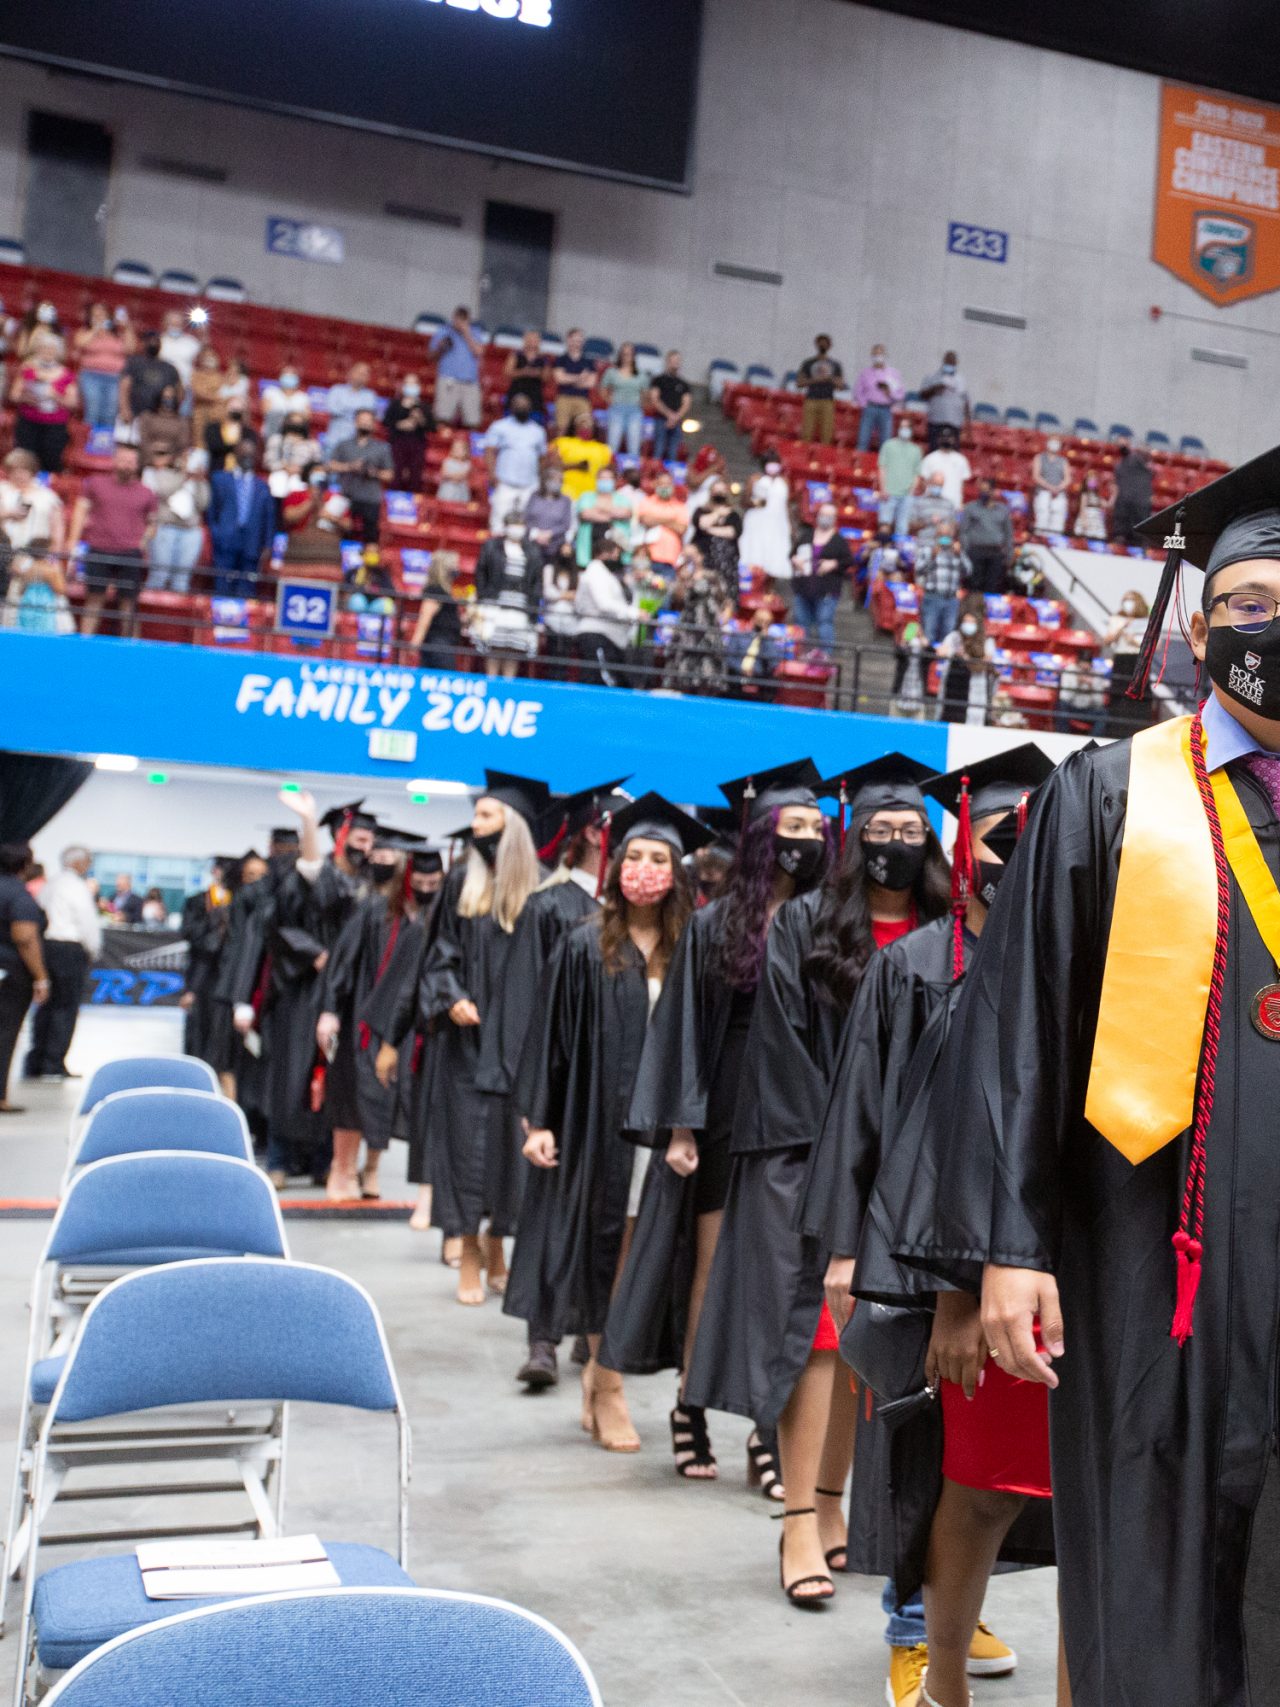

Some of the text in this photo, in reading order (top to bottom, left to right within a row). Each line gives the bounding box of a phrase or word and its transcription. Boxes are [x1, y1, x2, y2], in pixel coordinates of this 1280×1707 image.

[952, 227, 1002, 258] 233
[1163, 535, 1186, 549] 2021
[286, 594, 327, 624] 32
[300, 663, 487, 698] LAKELAND MAGIC
[1229, 672, 1264, 700] STATE
[1230, 663, 1266, 692] POLK
[235, 674, 543, 738] FAMILY ZONE
[90, 968, 185, 1005] RP
